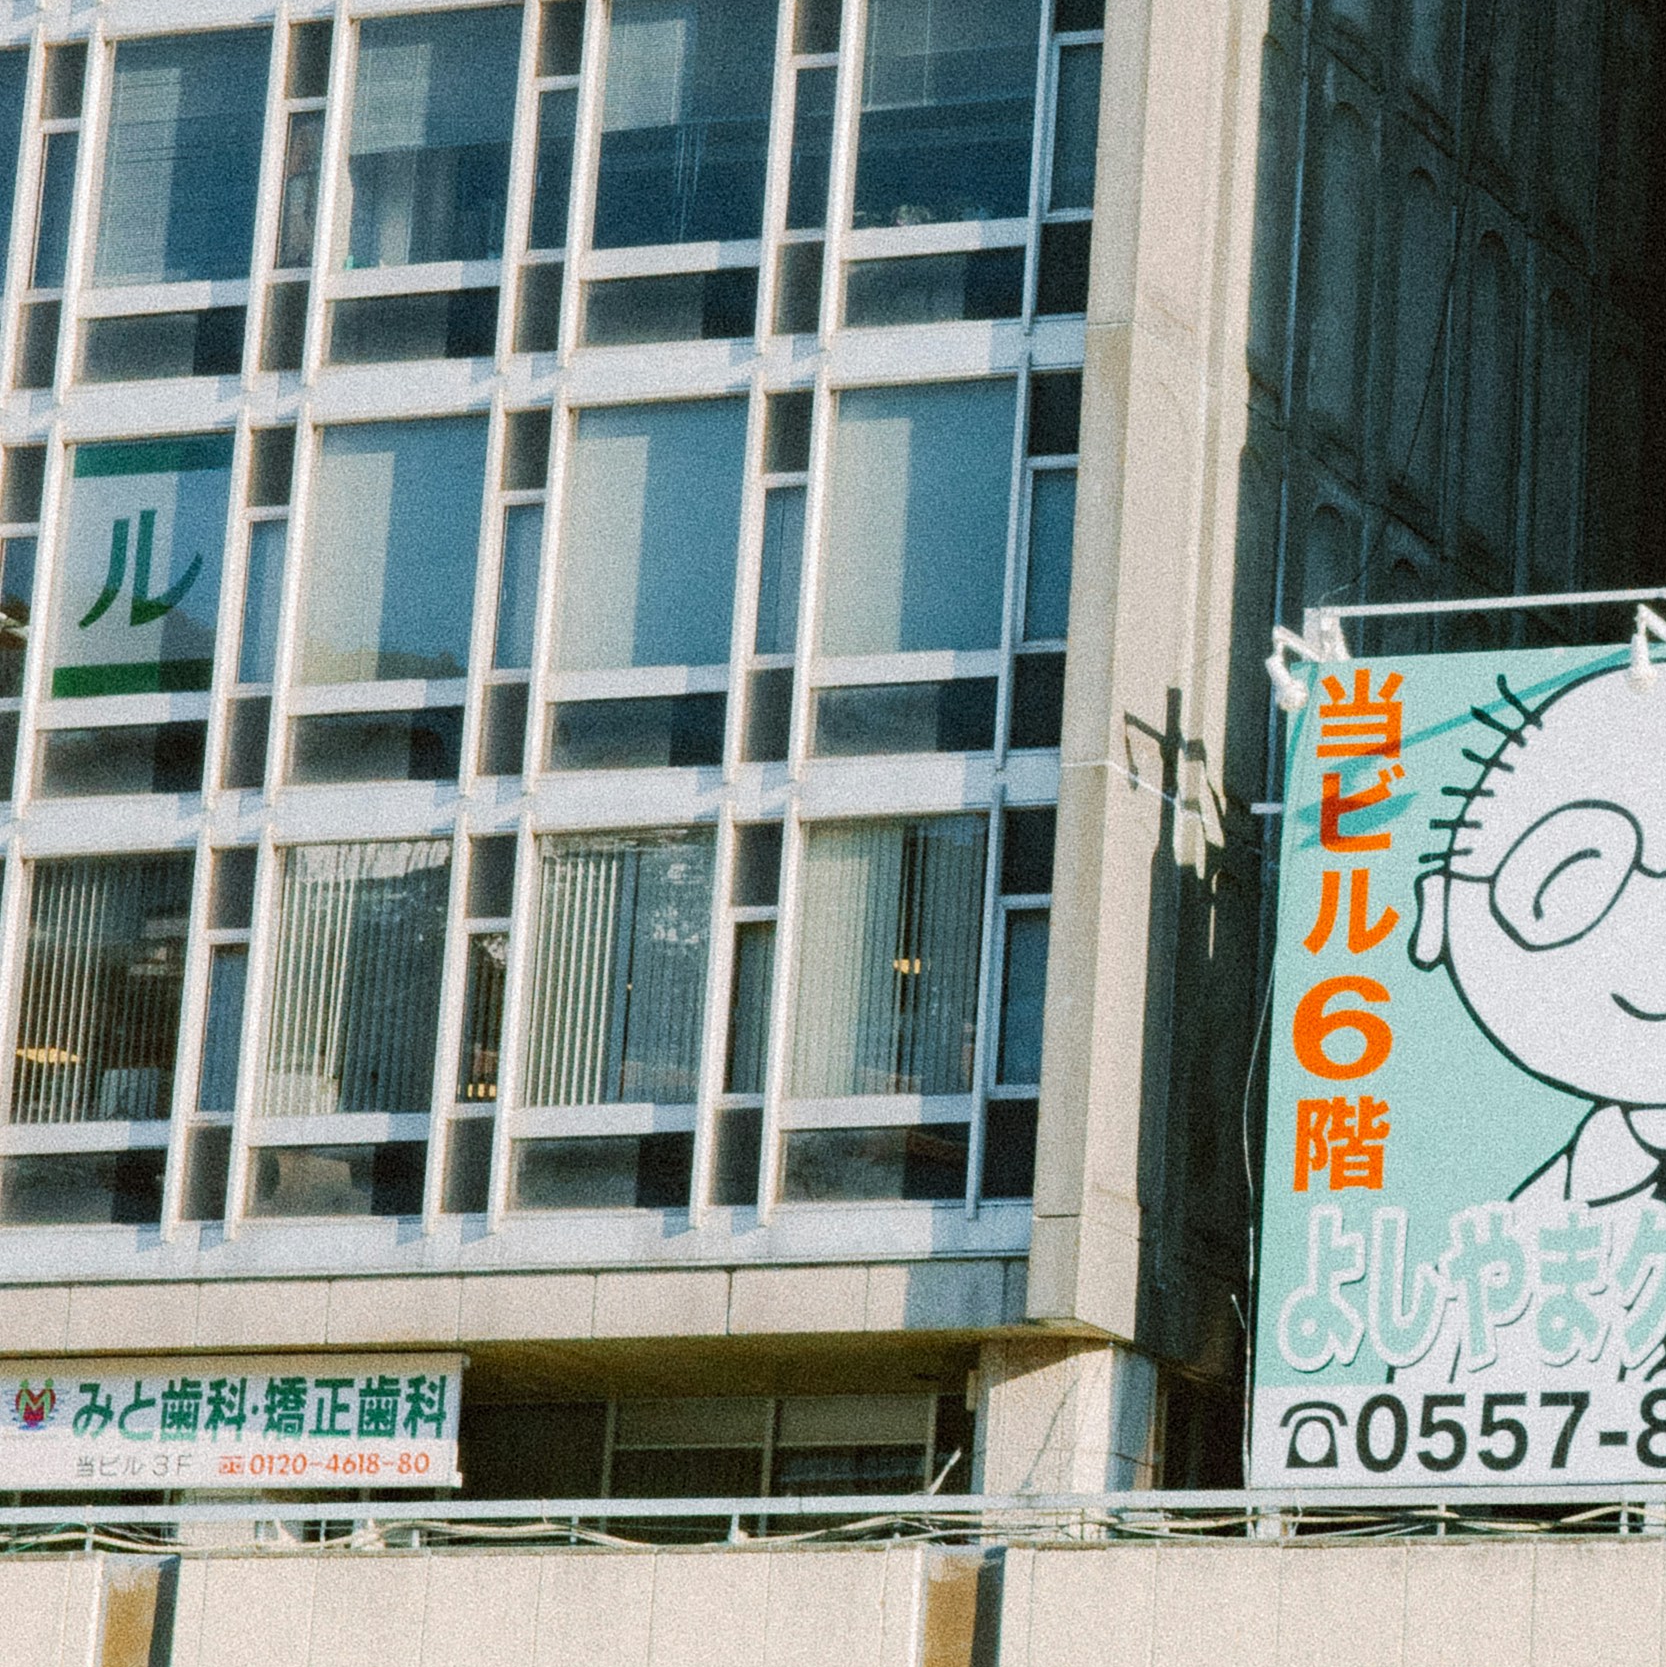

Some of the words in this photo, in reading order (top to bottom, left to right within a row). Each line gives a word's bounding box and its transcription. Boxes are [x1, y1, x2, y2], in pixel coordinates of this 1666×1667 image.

[78, 509, 203, 630] ル
[1291, 667, 1406, 1195] 当ビル6階
[72, 1374, 449, 1442] みと歯科・矯正歯科
[248, 1451, 431, 1476] 0120-4618-80
